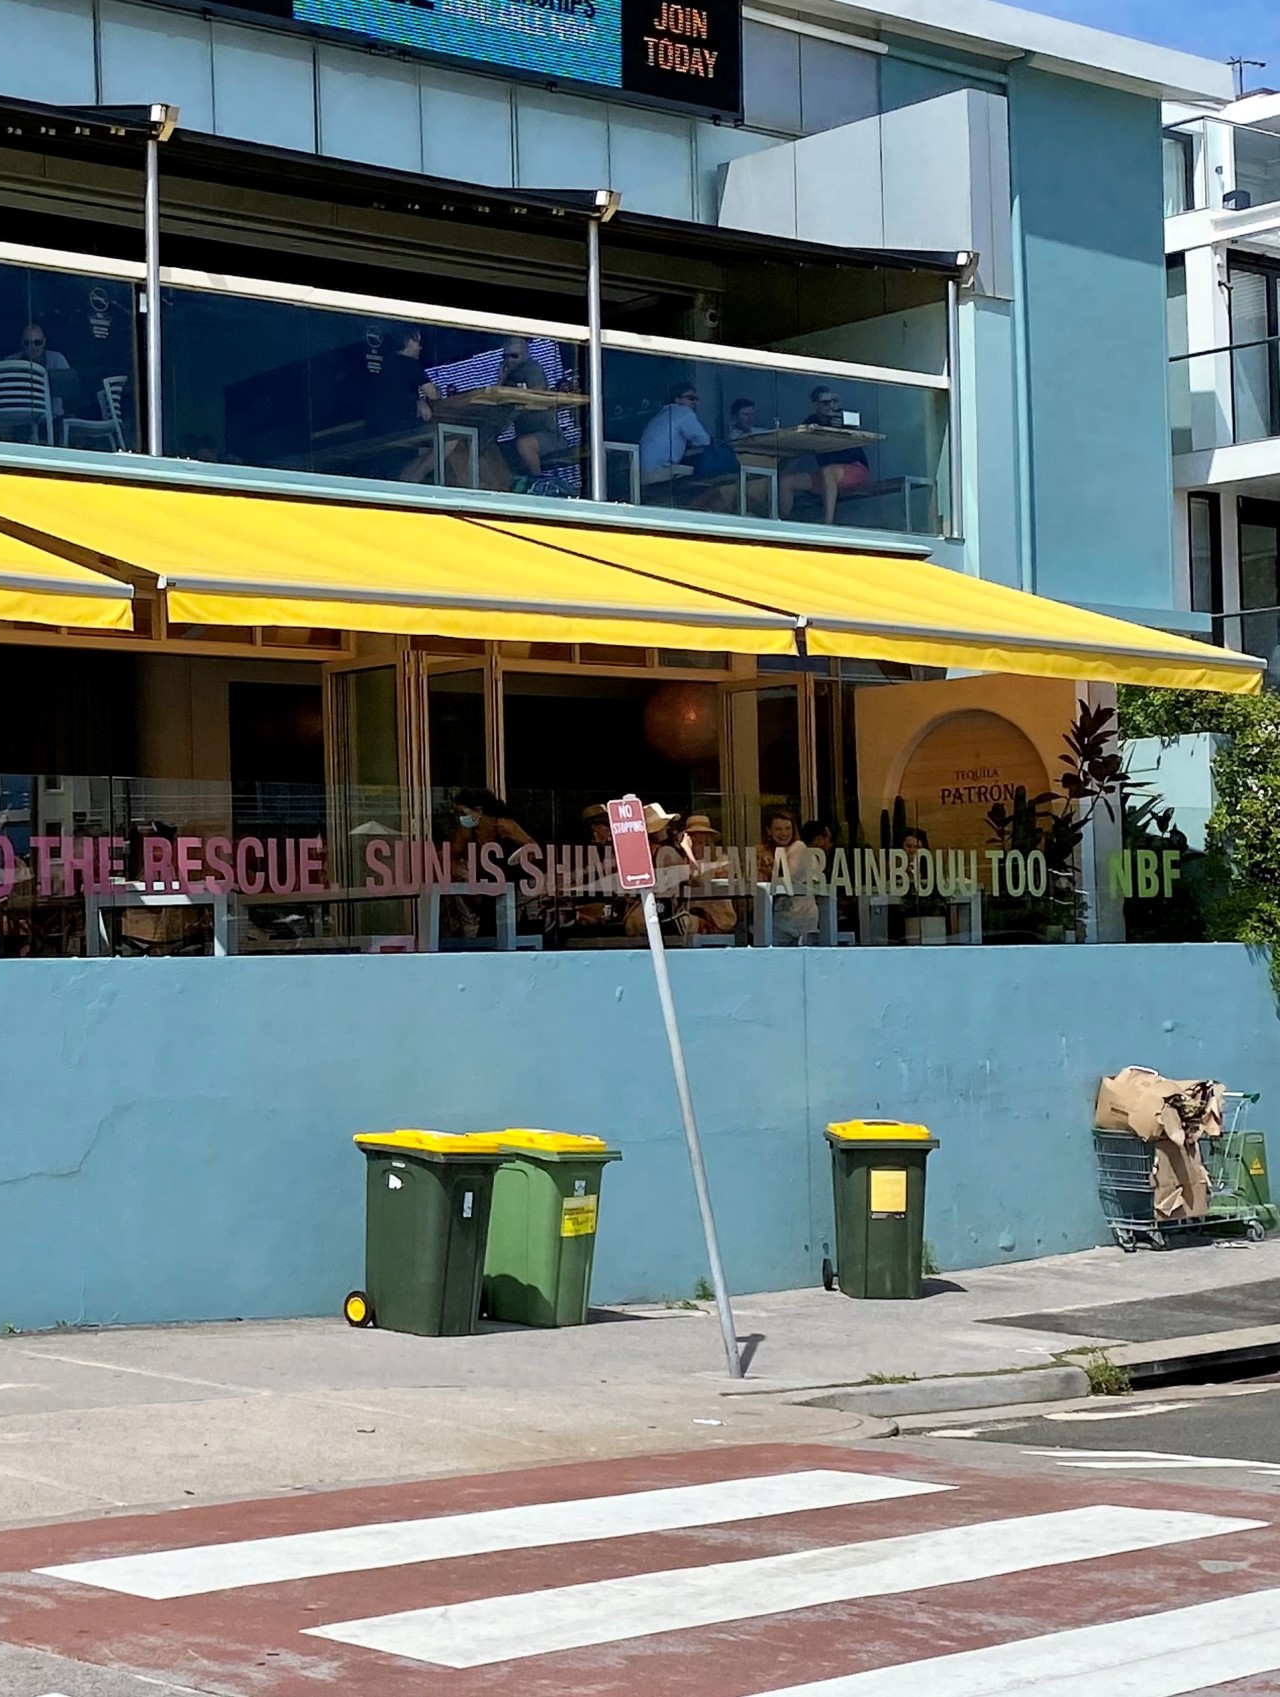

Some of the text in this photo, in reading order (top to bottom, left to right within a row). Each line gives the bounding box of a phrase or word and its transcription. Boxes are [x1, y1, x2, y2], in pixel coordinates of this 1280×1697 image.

[653, 2, 707, 39] JOIN
[643, 36, 718, 78] TODAY
[955, 768, 999, 781] TEQUILA
[941, 780, 1015, 805] PATRÓN
[618, 804, 633, 819] NO
[612, 820, 644, 835] STOPPING
[30, 836, 128, 895] THE
[365, 839, 453, 896] SUN
[467, 841, 506, 896] IS
[771, 846, 795, 897] A
[985, 849, 1048, 898] TOO
[1109, 848, 1182, 899] NBF
